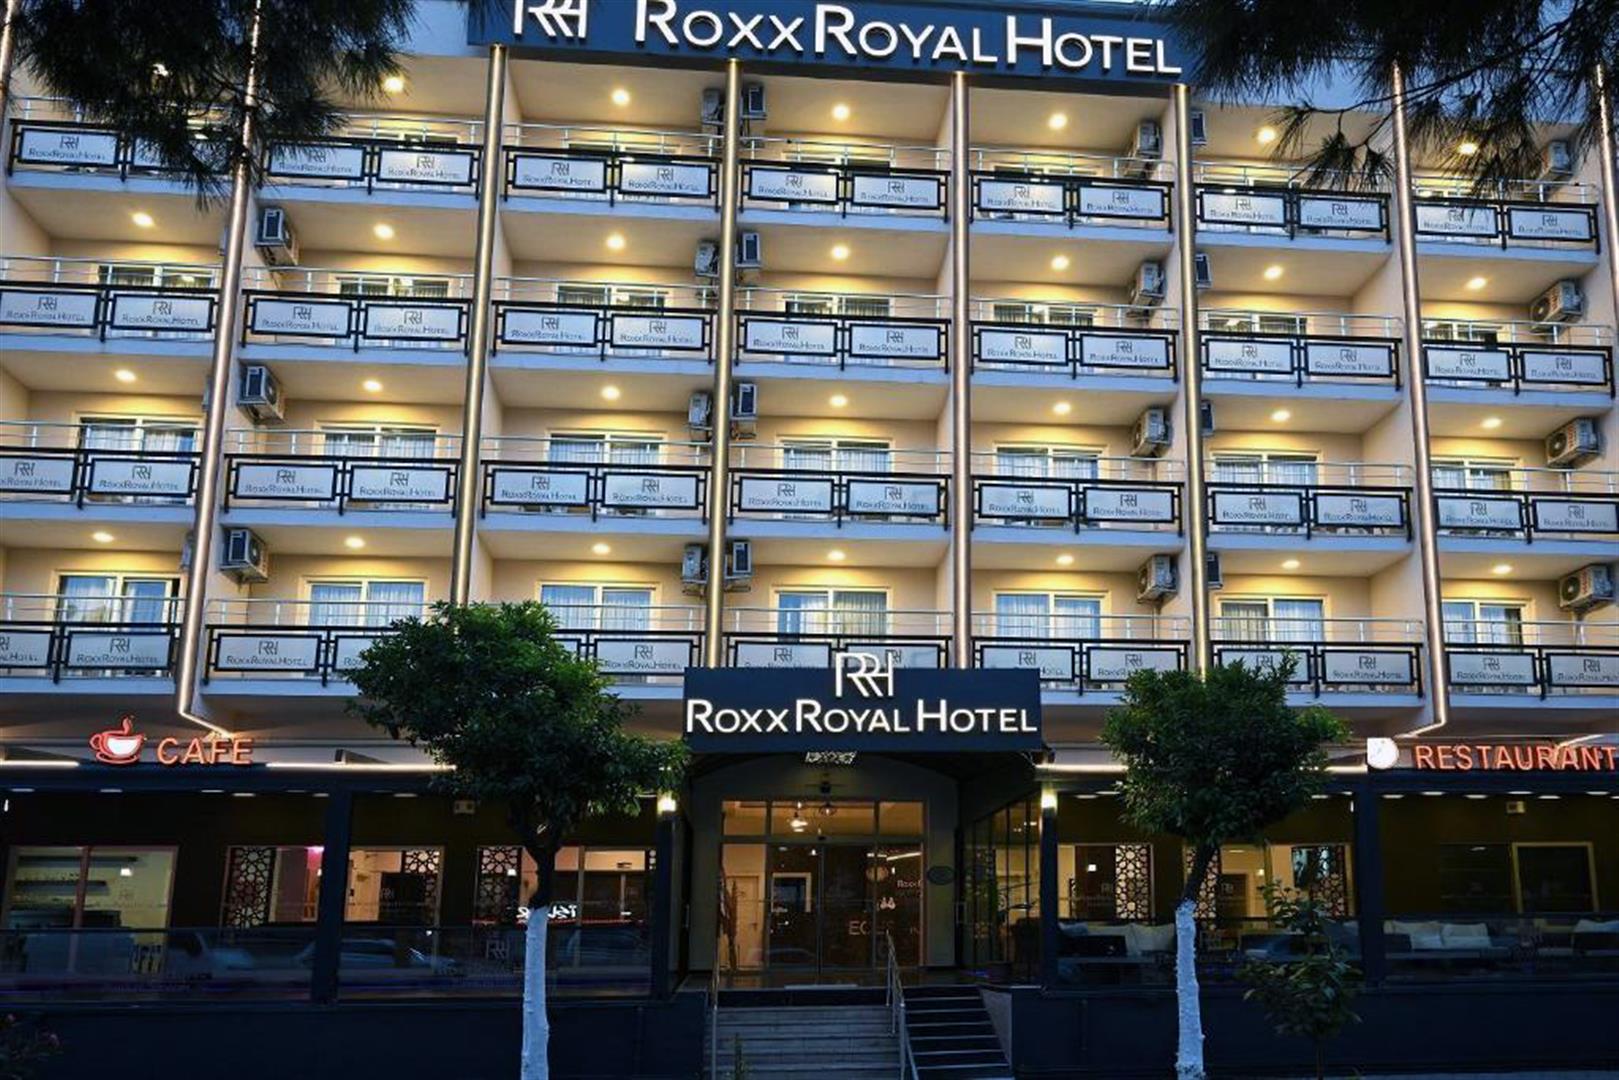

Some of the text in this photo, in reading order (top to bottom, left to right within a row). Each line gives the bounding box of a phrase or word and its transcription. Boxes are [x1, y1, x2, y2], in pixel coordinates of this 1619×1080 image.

[815, 4, 998, 62] ROYAL
[1007, 15, 1182, 73] HOTEL
[686, 699, 1038, 733] ROXX ROYAL HOTEL
[157, 737, 253, 765] CAFE
[1415, 745, 1618, 770] RESTAURANT
